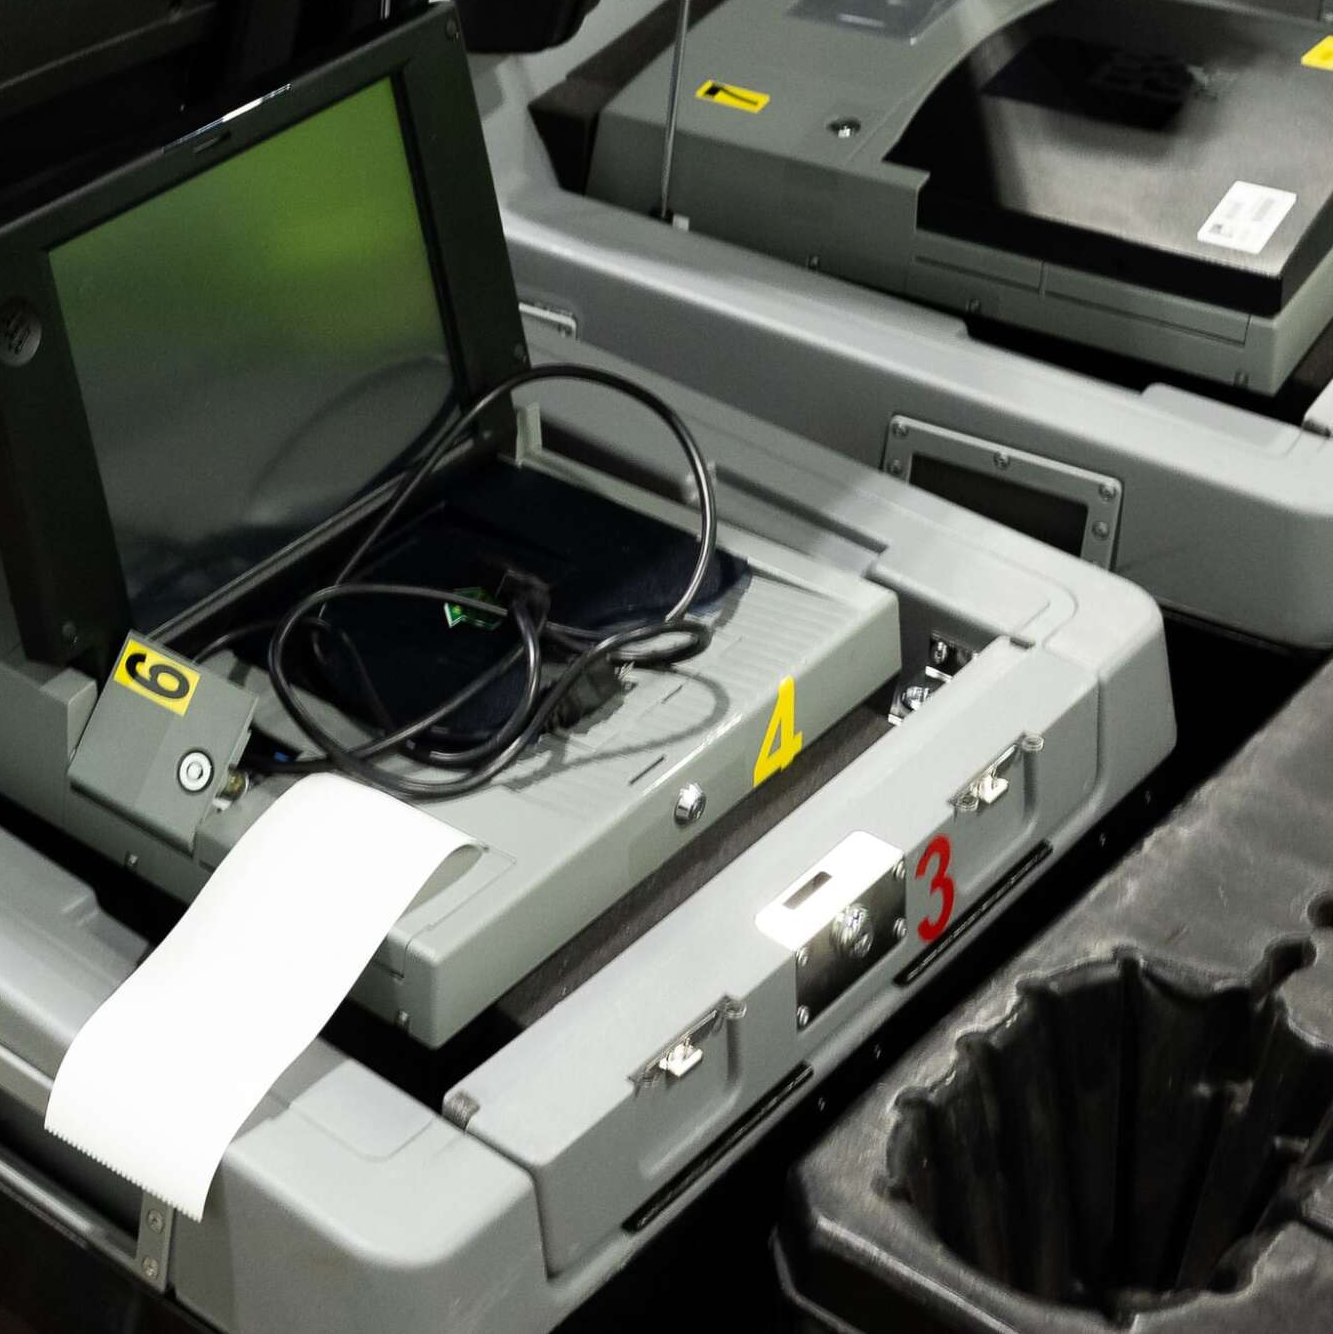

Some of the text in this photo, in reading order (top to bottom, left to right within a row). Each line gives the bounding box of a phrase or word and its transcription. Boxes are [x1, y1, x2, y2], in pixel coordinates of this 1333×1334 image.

[124, 652, 191, 700] 6
[753, 676, 802, 787] 4
[915, 833, 957, 943] 3
